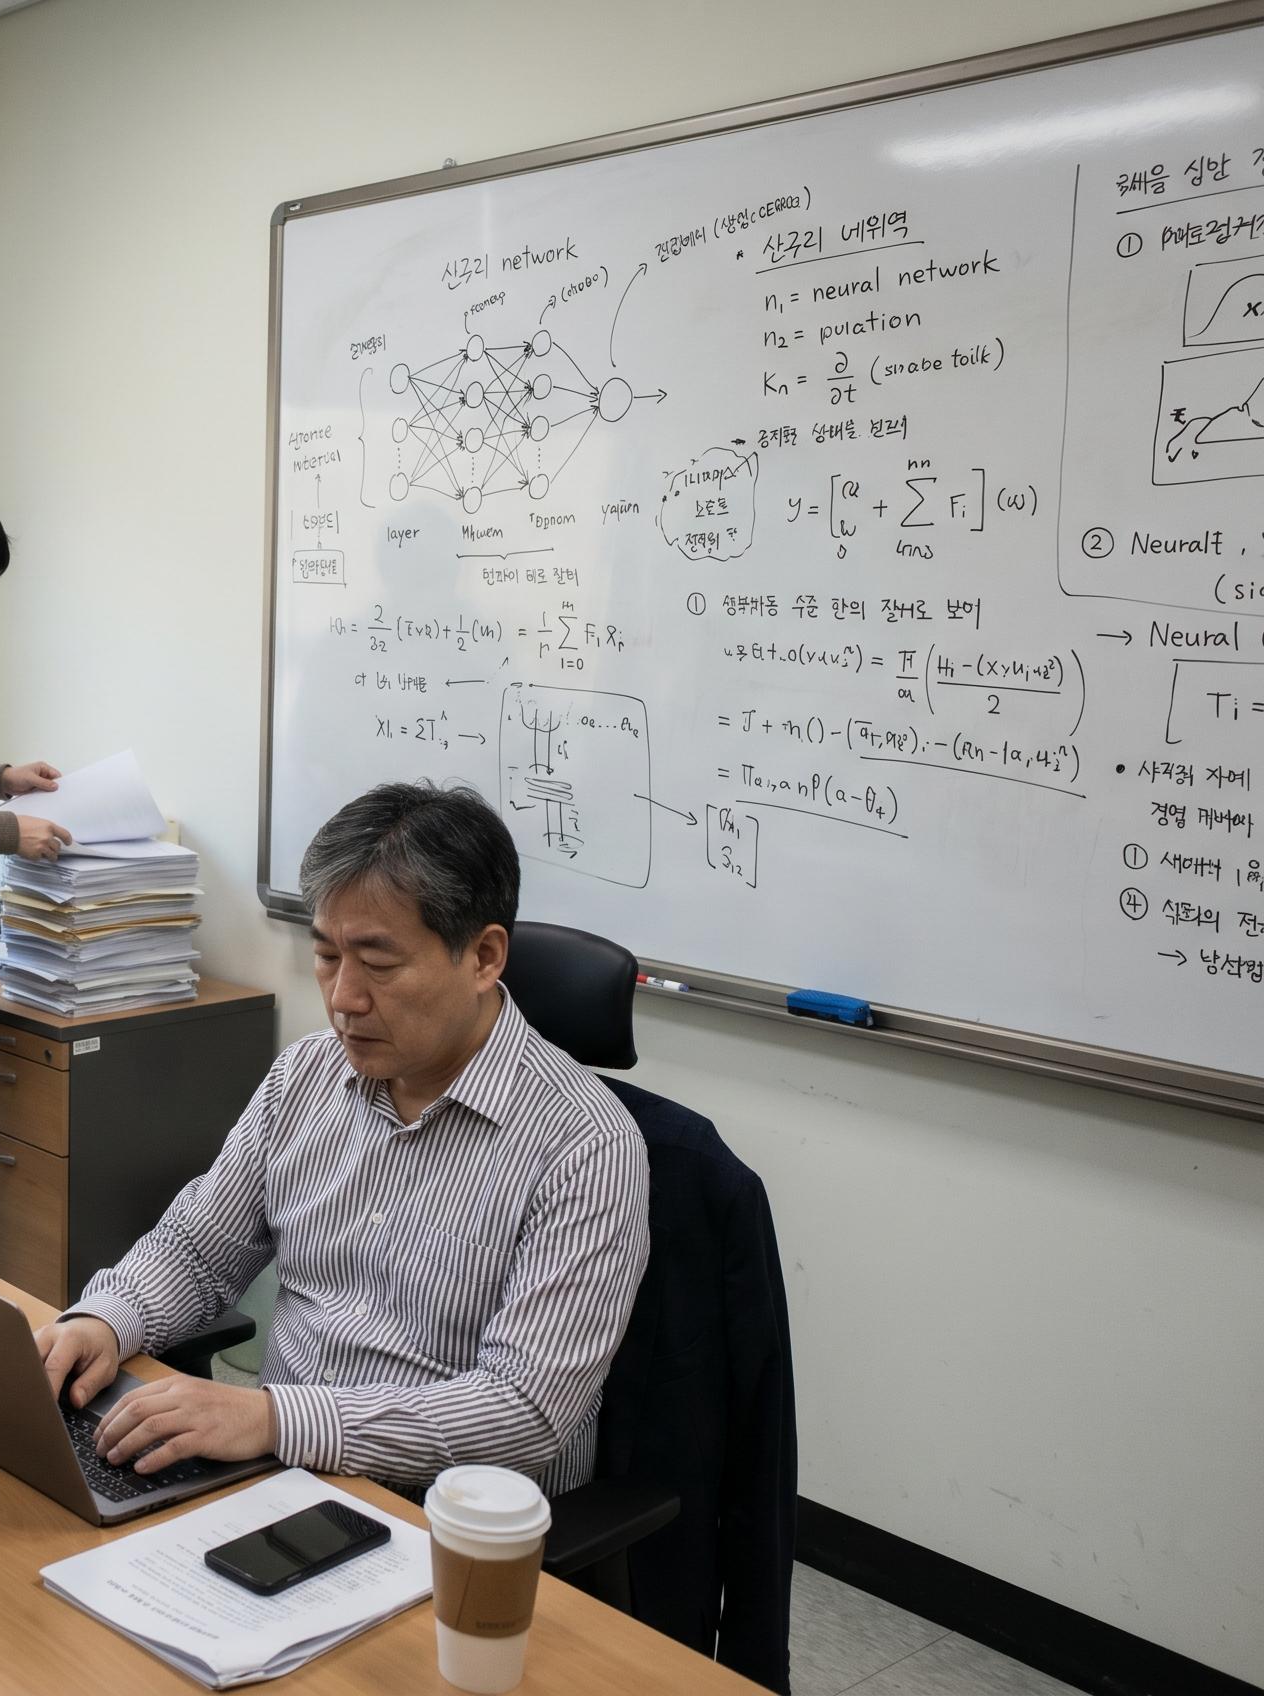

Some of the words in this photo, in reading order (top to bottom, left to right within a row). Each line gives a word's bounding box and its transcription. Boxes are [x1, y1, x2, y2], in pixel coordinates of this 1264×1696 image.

[502, 237, 579, 272] network
[813, 266, 880, 302] neural
[899, 249, 1000, 286] network
[387, 527, 421, 548] layer
[1150, 620, 1239, 651] Neural
